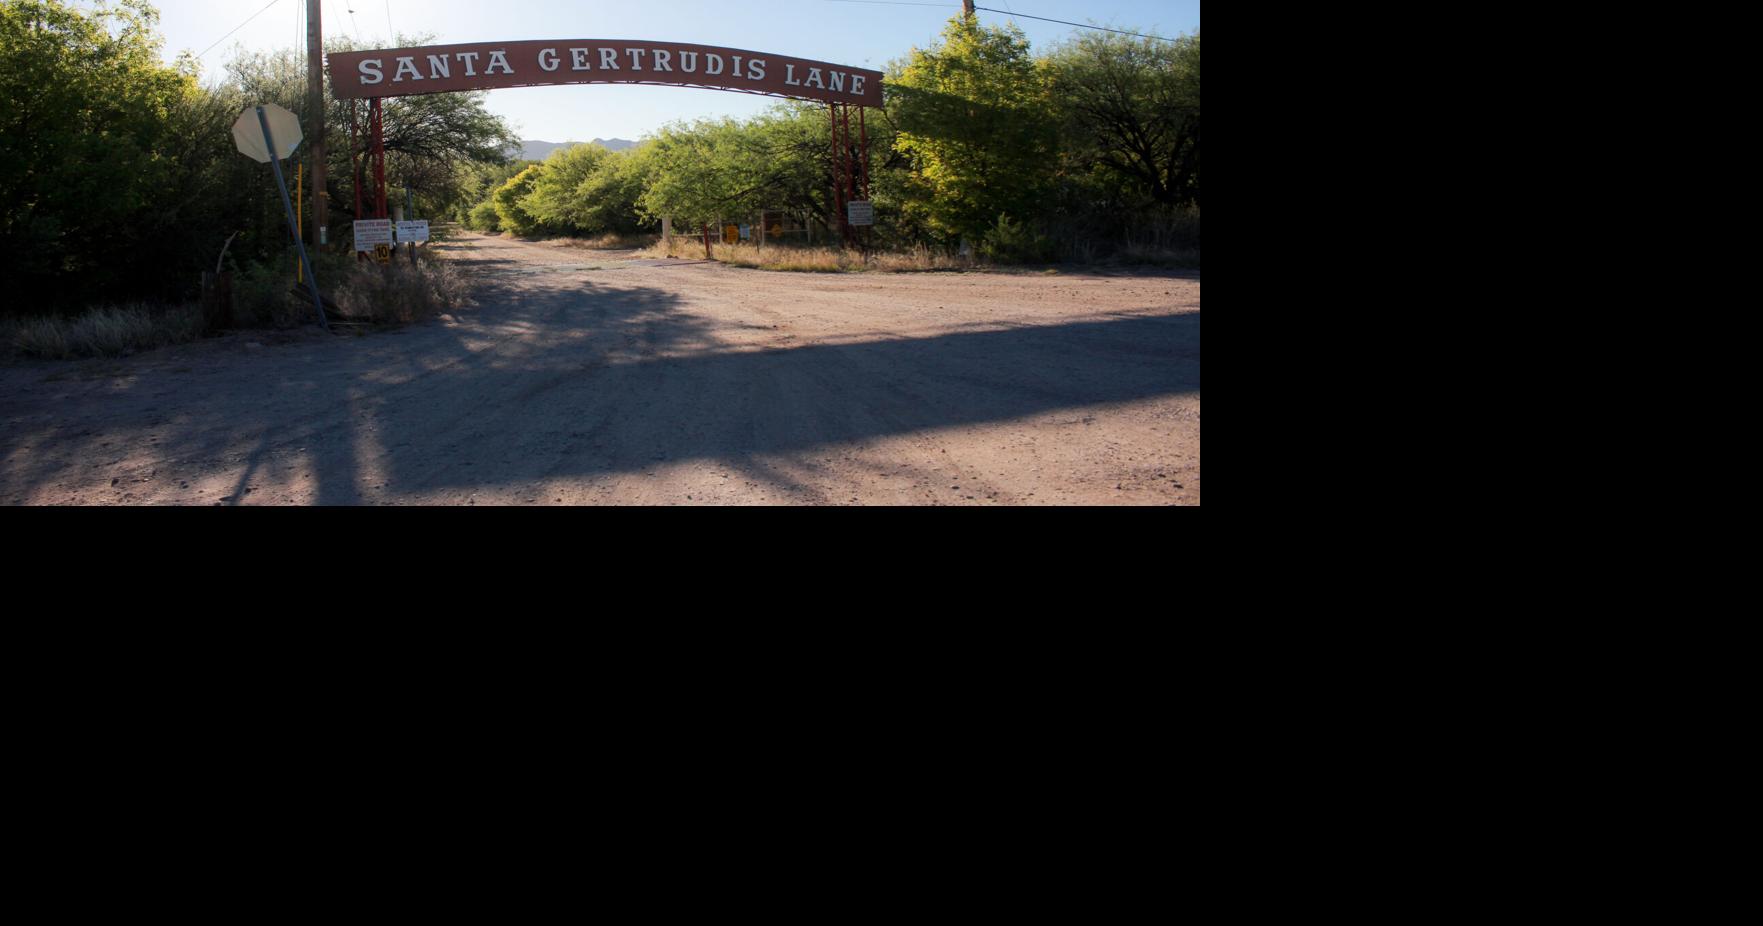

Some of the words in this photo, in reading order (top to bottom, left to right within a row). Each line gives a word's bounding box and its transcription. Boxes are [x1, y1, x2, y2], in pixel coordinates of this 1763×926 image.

[358, 49, 515, 85] SANTA
[538, 47, 766, 80] GERTRUDIS
[785, 64, 866, 95] LANE
[377, 246, 388, 258] 10
